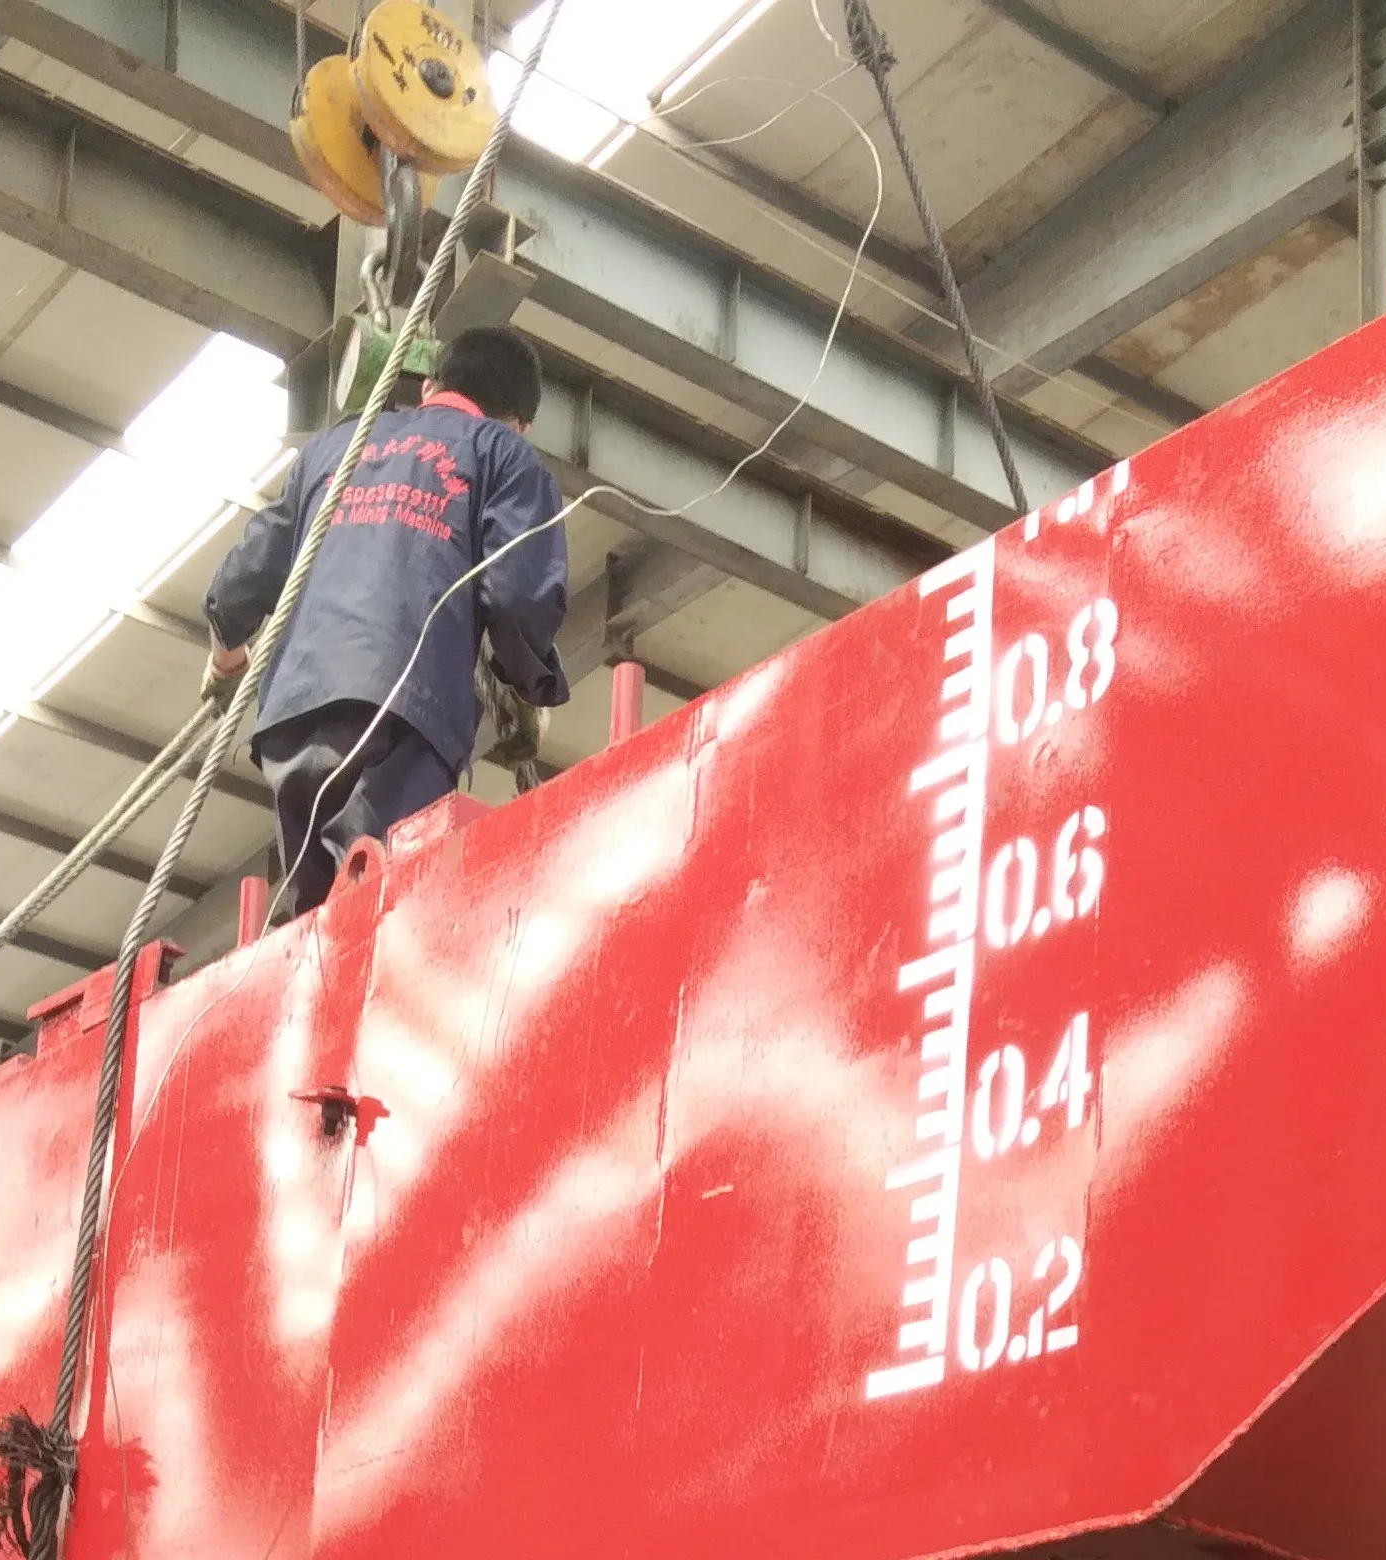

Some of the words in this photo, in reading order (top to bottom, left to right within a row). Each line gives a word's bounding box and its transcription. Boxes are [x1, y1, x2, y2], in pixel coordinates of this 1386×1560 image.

[998, 598, 1119, 744] 0.8
[984, 805, 1106, 949] 0.6
[972, 1011, 1092, 1159] 0.4
[958, 1235, 1083, 1372] 0.2
